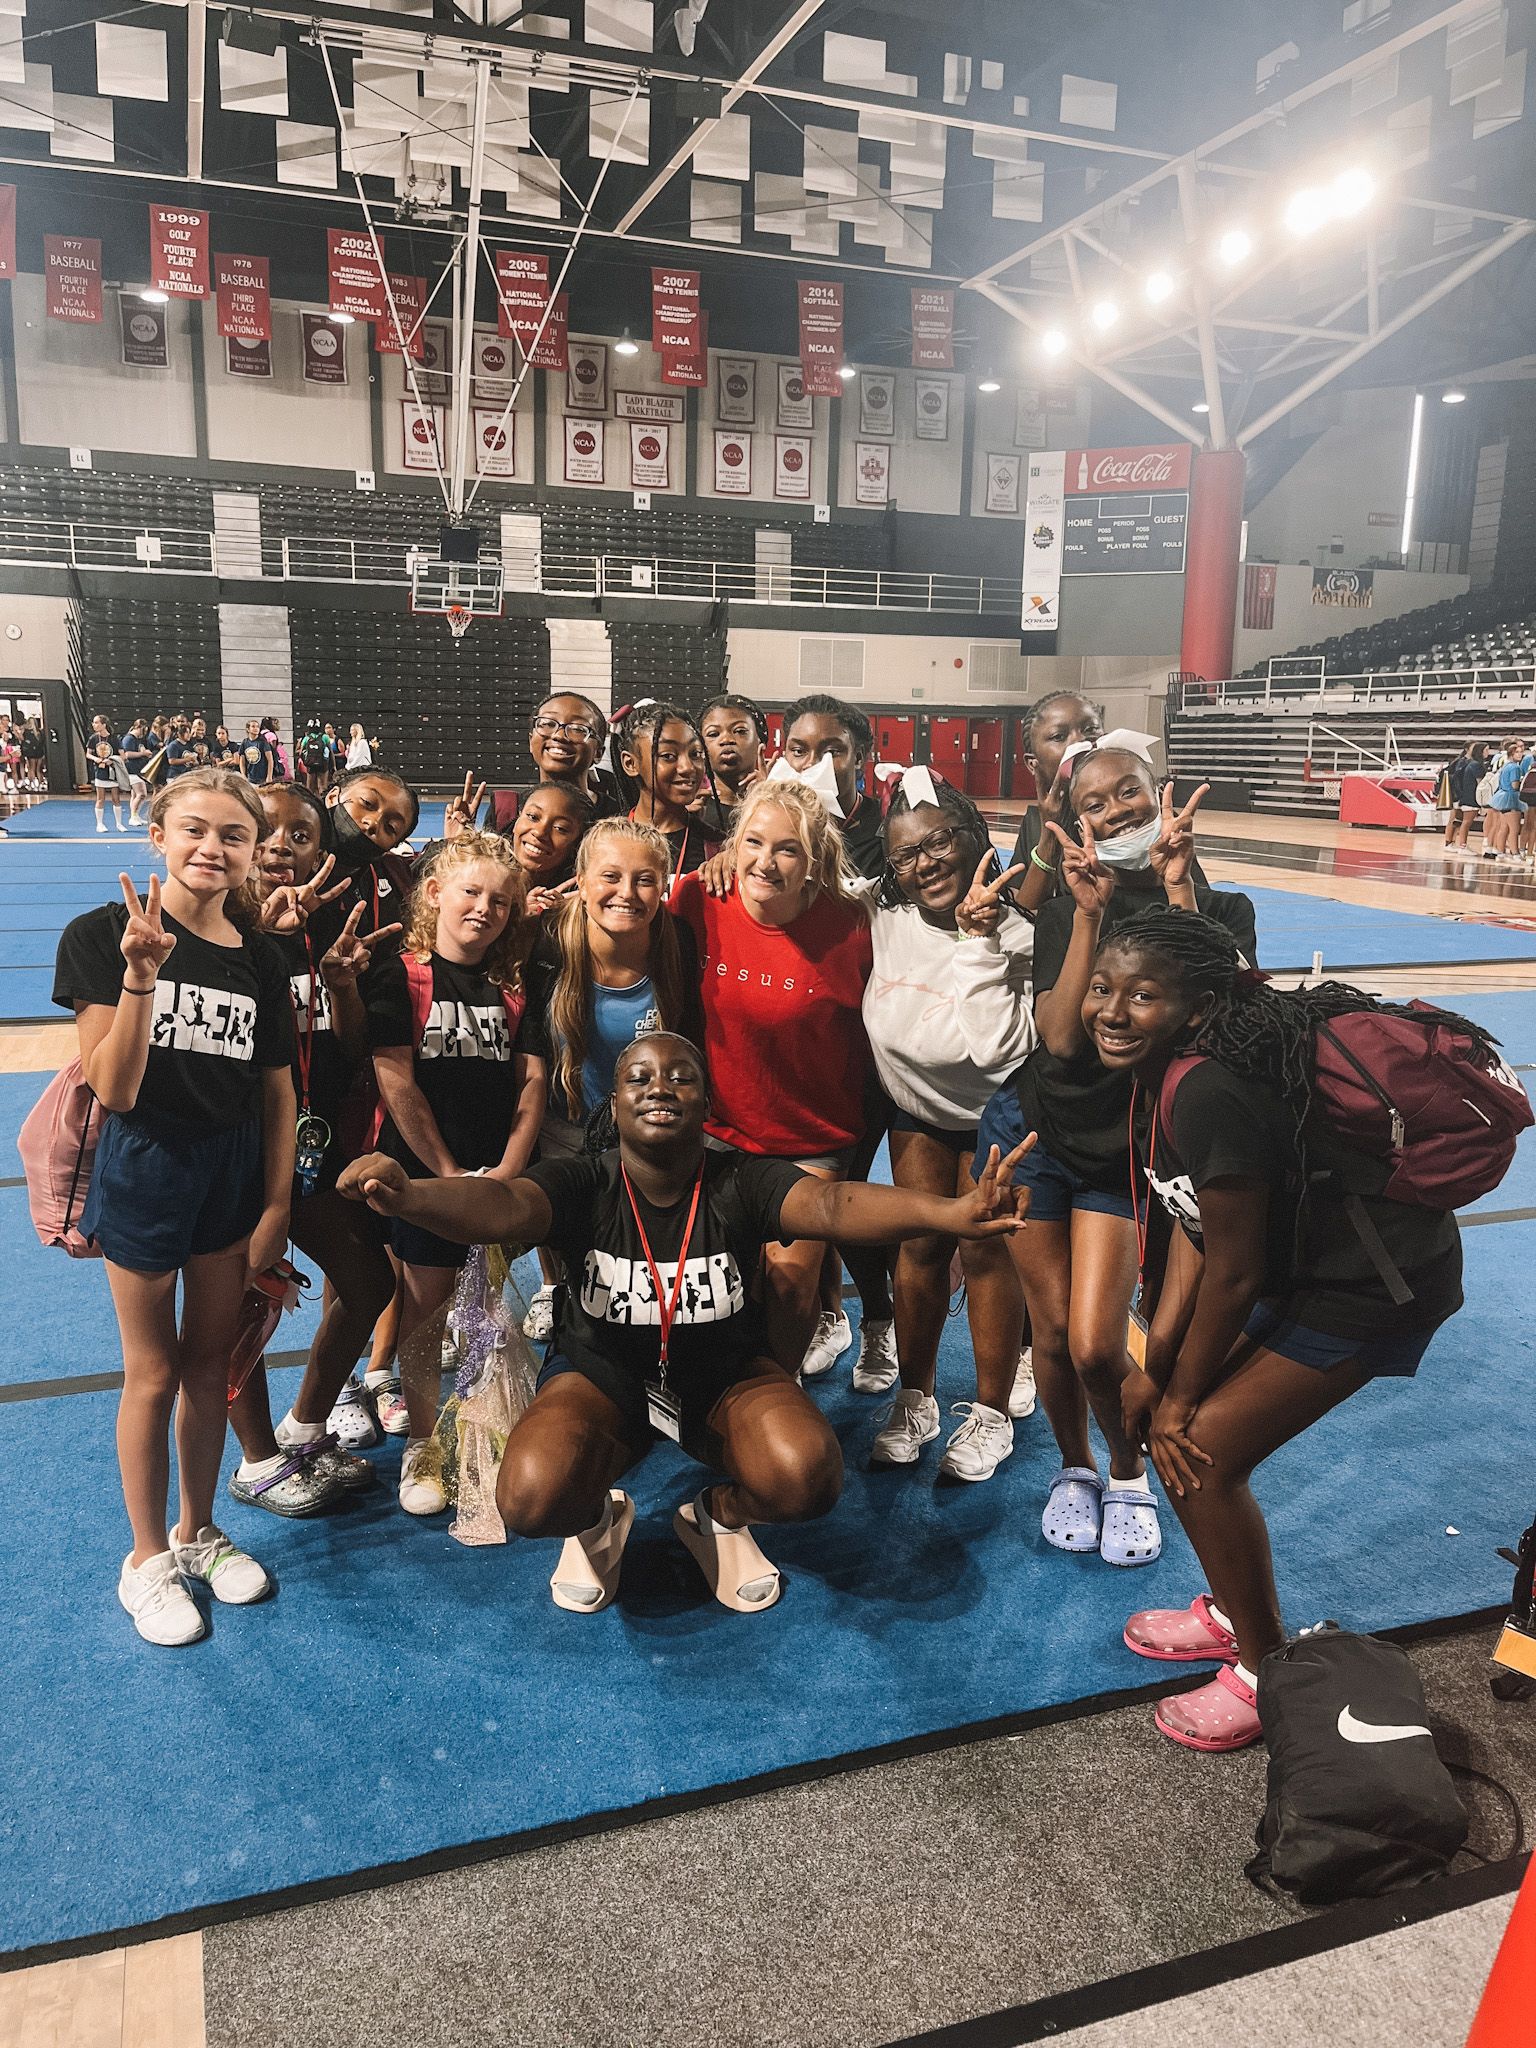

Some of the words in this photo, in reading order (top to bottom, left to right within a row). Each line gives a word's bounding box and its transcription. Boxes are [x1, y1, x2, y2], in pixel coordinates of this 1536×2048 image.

[159, 212, 200, 226] 1999
[169, 230, 191, 241] GOLF
[63, 241, 82, 250] 1977
[341, 237, 372, 252] 2002
[163, 244, 196, 258] FOURTH
[334, 247, 379, 260] FOOTBALL
[50, 254, 97, 272] BASEBALL
[167, 255, 194, 268] PLACE
[233, 259, 252, 269] 1978
[508, 260, 538, 272] 2005
[340, 266, 374, 276] NATIONAL
[59, 274, 88, 286] FOURTH
[169, 271, 192, 282] NCAA
[220, 273, 266, 290] BASEBALL
[332, 271, 382, 284] CHAMPIONSHIP
[158, 280, 204, 294] NATIONALS
[392, 278, 408, 286] 1983
[663, 276, 690, 288] 2007
[61, 285, 87, 296] PLACE
[506, 290, 542, 300] NATIONAL
[808, 287, 834, 298] 2014
[62, 298, 86, 308] NCAA
[232, 294, 254, 304] THIRD
[345, 296, 370, 306] NCAA
[500, 298, 548, 308] SEMIFINALIST
[803, 298, 840, 306] SOFTBALL
[920, 294, 944, 304] 2021
[53, 306, 96, 319] NATIONALS
[232, 302, 256, 314] PLACE
[333, 303, 382, 316] NATIONALS
[662, 304, 690, 312] NATIONAL
[914, 304, 950, 312] FOOTBALL
[655, 310, 697, 318] CHAMPIONSHIP
[232, 316, 255, 326] NCAA
[510, 320, 540, 330] NCAA
[224, 323, 264, 337] NATIONALS
[312, 338, 336, 348] NCAA
[662, 335, 690, 346] NCAA
[808, 344, 835, 354] NCAA
[482, 355, 504, 364] NCAA
[920, 350, 944, 359] NCAA
[532, 356, 562, 367] ATIONALS
[576, 367, 598, 376] NCAA
[676, 364, 693, 372] NCAA
[668, 370, 702, 380] NATIONALS
[625, 396, 644, 405] LADY
[646, 398, 675, 408] BLAZER
[626, 405, 674, 418] BASKETBALL
[574, 438, 596, 448] NCAA
[640, 445, 660, 453] NCAA
[76, 454, 84, 462] LL
[784, 456, 802, 464] NCAA
[1093, 452, 1178, 484] Coca-Cola
[1068, 519, 1093, 527] HOME
[1154, 514, 1184, 524] GUEST
[146, 544, 150, 553] L
[640, 572, 644, 580] N
[700, 954, 814, 994] Jesus.
[580, 1248, 744, 1326] CHEER
